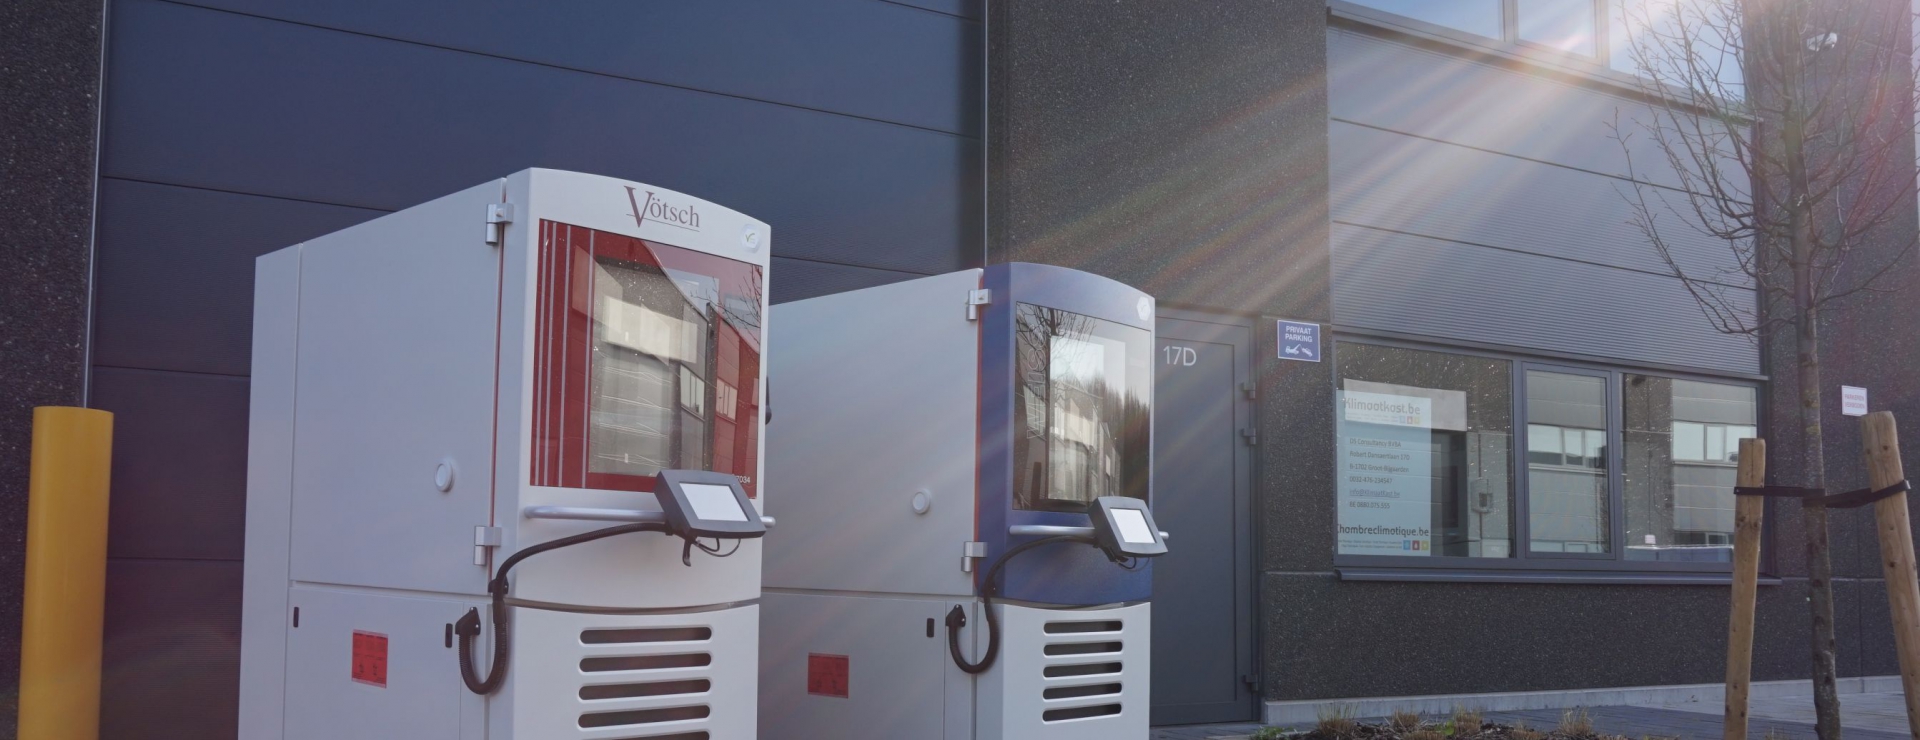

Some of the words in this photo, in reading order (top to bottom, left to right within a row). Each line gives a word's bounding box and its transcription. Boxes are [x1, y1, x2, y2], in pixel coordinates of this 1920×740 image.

[624, 185, 699, 228] Vötsch
[1285, 325, 1312, 335] PRIVAAT
[1285, 333, 1312, 343] PARKING
[1163, 345, 1197, 367] 17D
[1344, 397, 1421, 415] Klimaatkast.be
[1357, 438, 1387, 447] Consultancy
[1349, 450, 1367, 458] Robert
[1336, 523, 1430, 538] hambreclimatique.be
